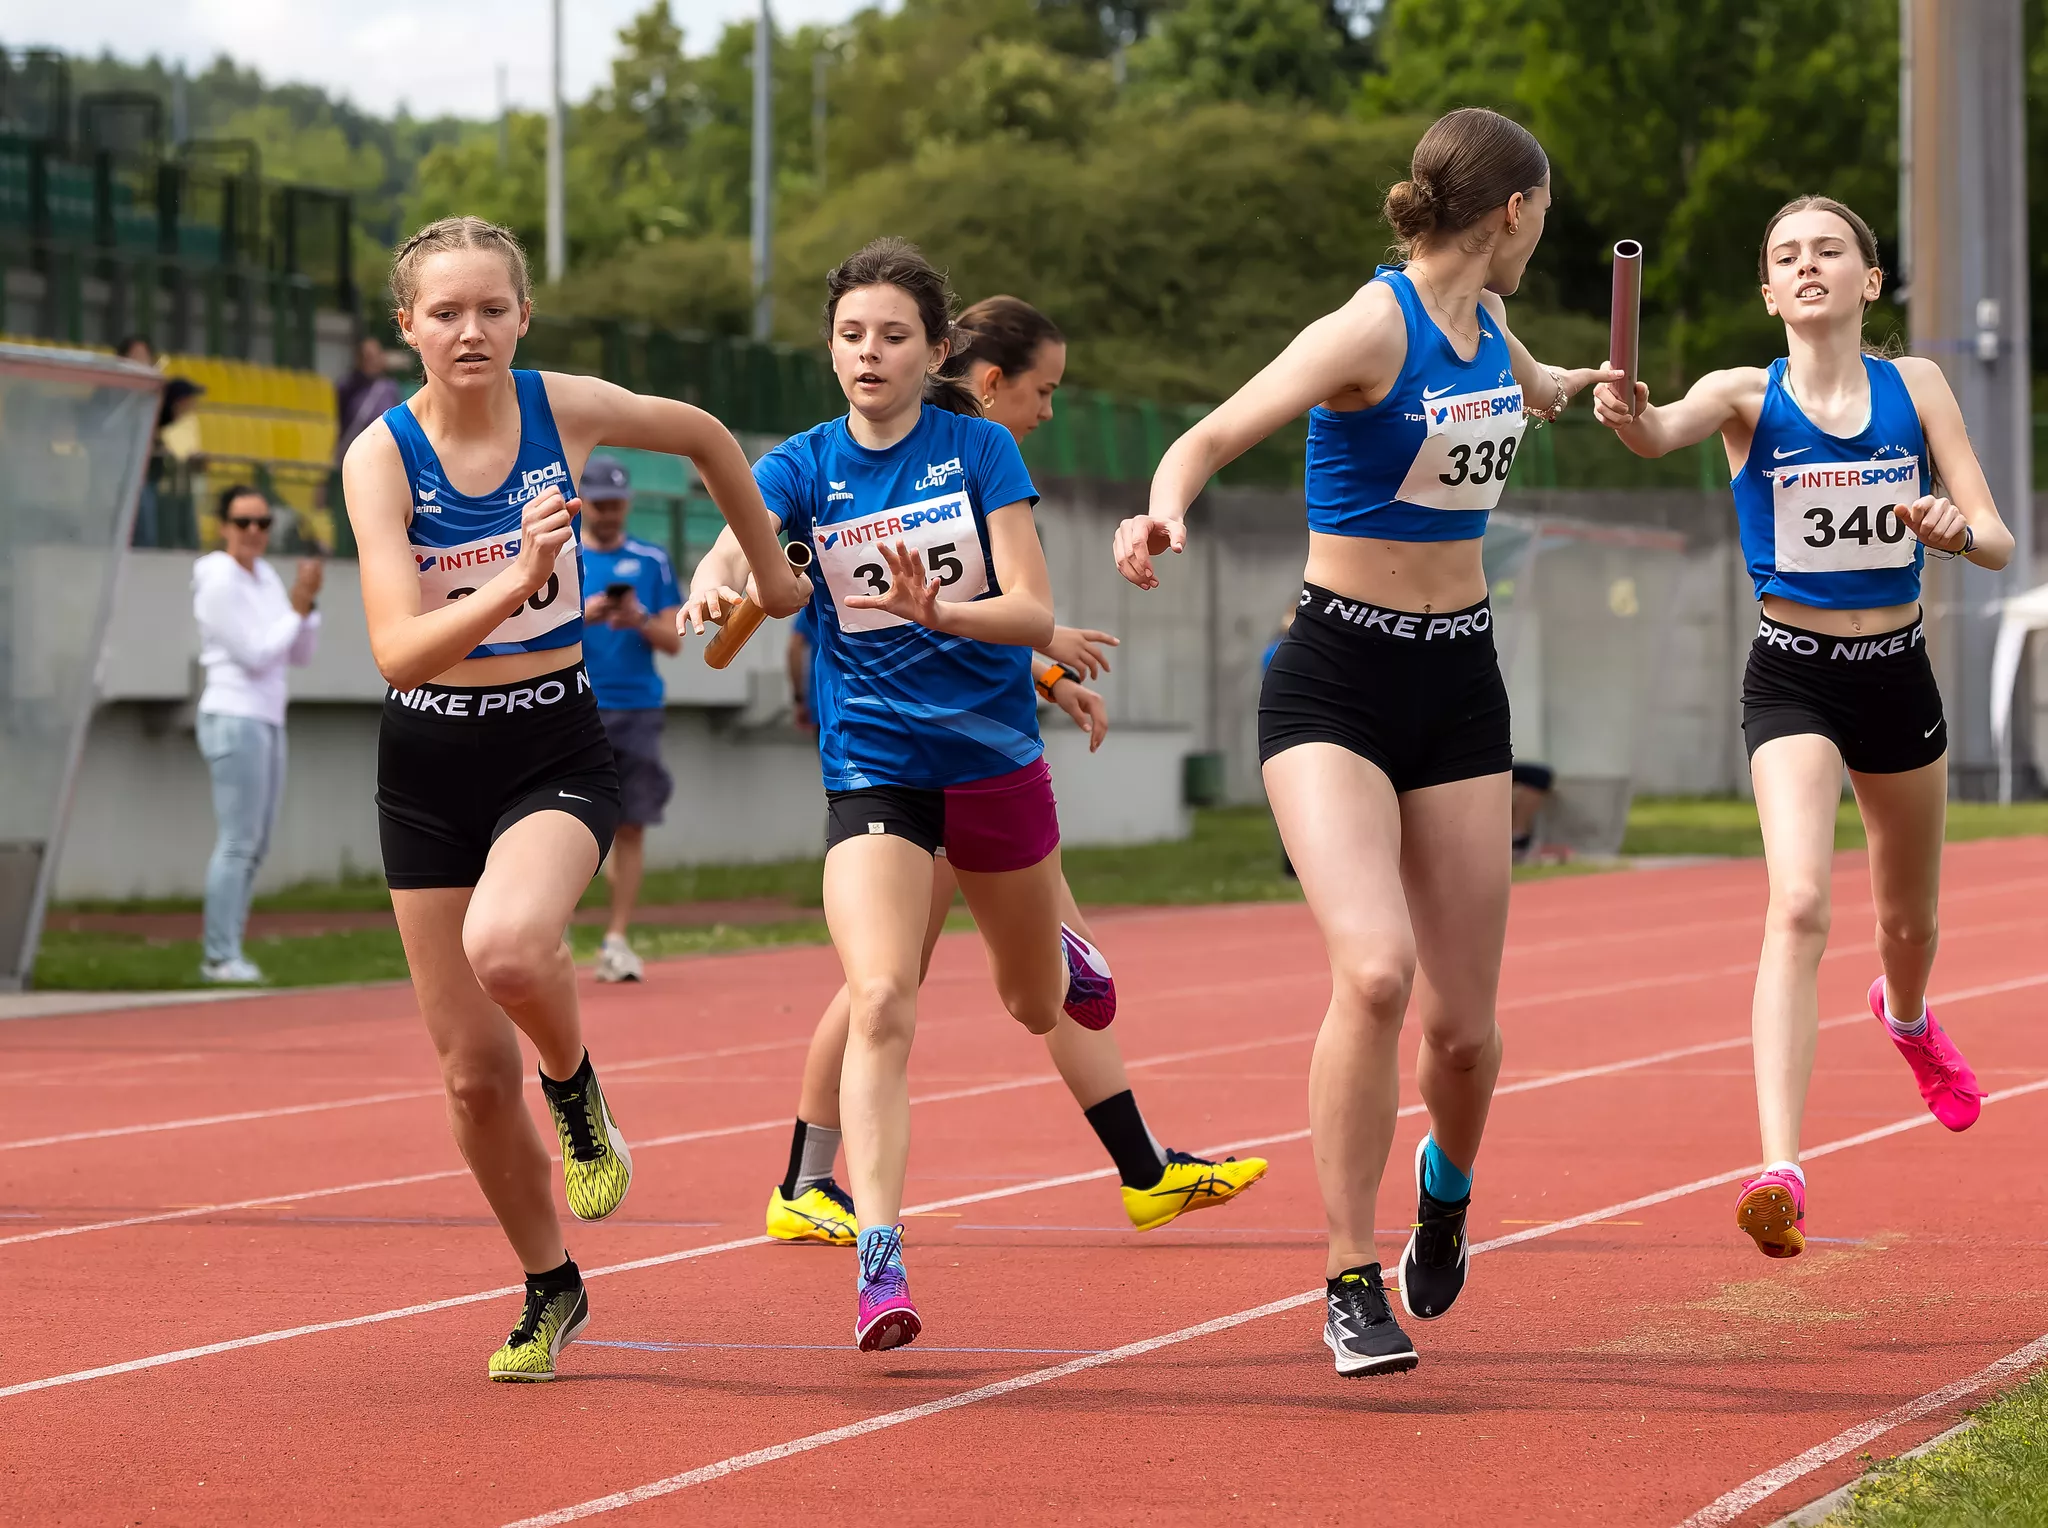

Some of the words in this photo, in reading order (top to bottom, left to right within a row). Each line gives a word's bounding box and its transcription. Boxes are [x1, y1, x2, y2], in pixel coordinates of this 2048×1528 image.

[1451, 395, 1522, 423] INTERSPORT
[1438, 436, 1517, 487] 338
[1895, 444, 1912, 458] LIN
[1802, 464, 1915, 488] INTERSPORT
[841, 501, 962, 548] INTERSPORT
[1803, 504, 1907, 548] 340
[440, 538, 522, 572] INTERS
[853, 542, 964, 597] 35
[1323, 598, 1422, 639] NIKE
[1425, 607, 1490, 641] PRO
[1757, 620, 1819, 655] PRO
[1830, 631, 1909, 660] NIKE
[390, 687, 473, 717] NIKE
[478, 678, 566, 717] PRO
